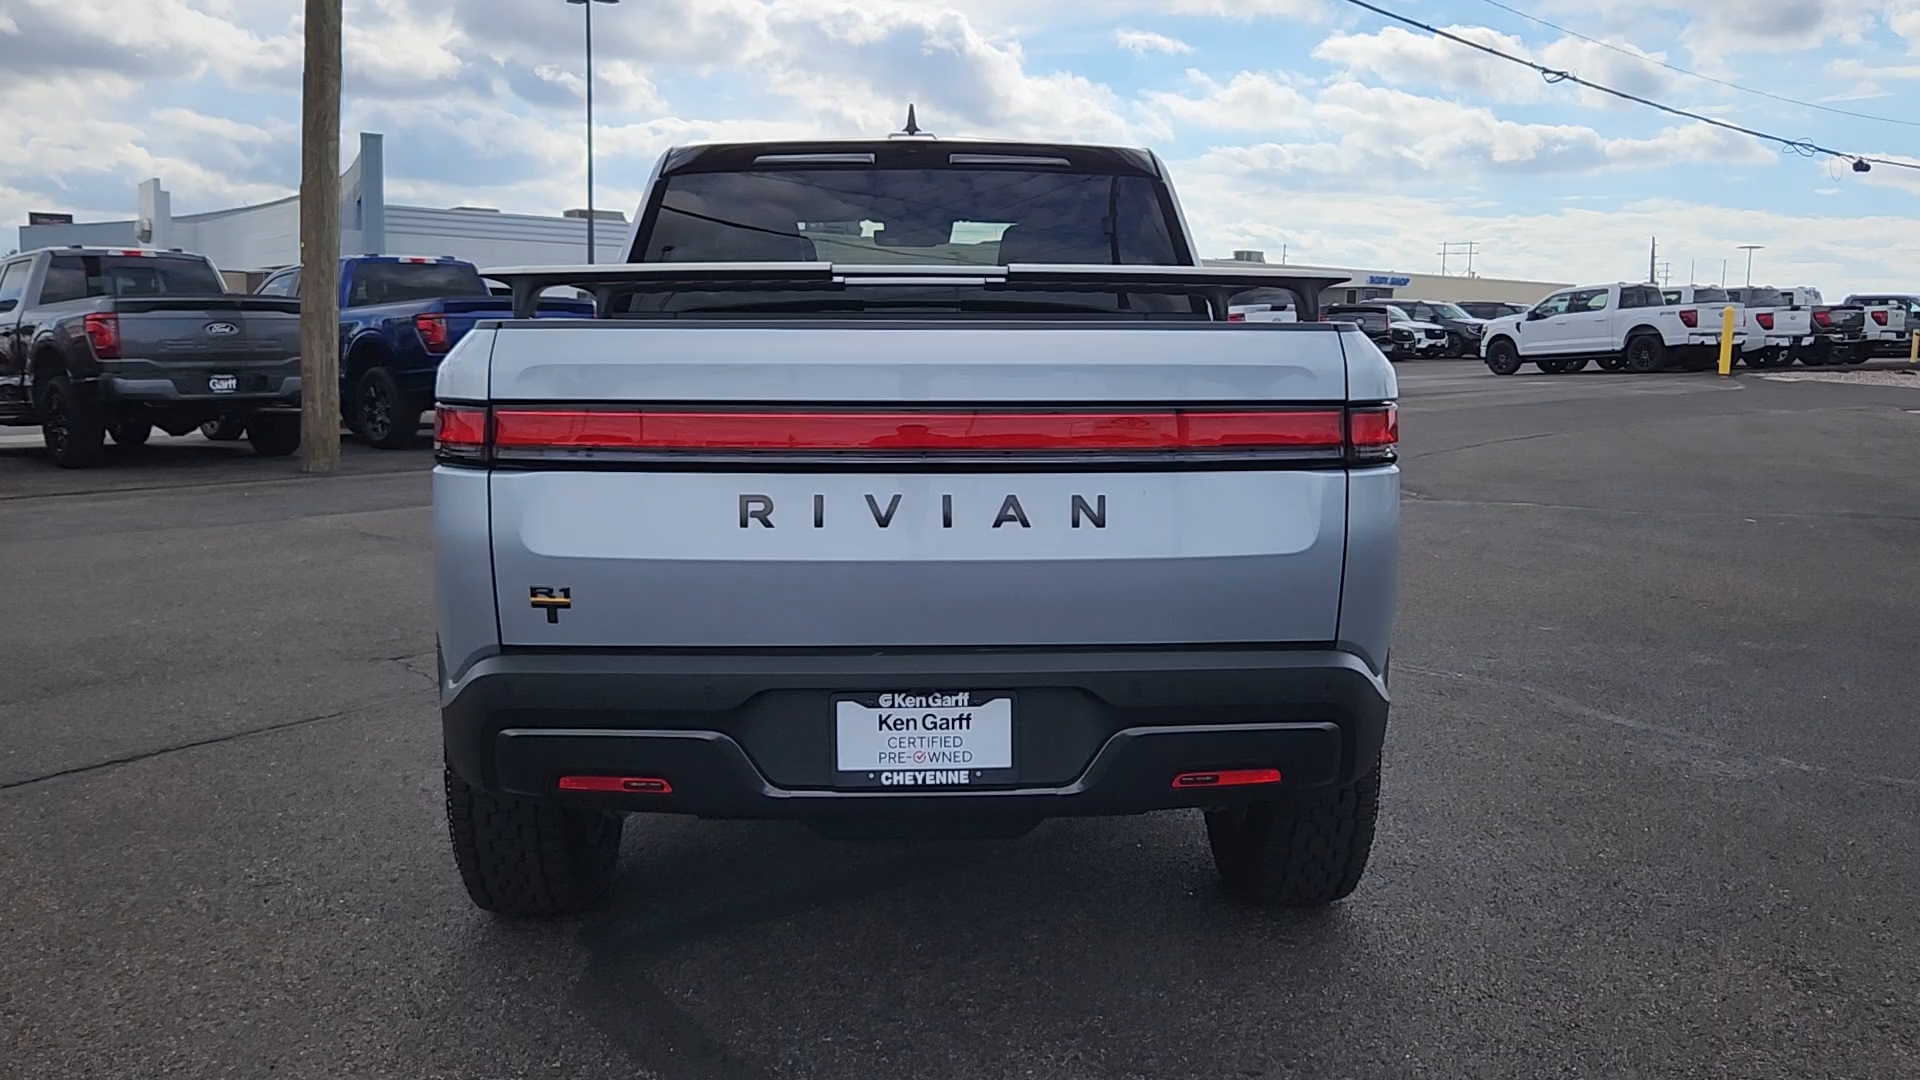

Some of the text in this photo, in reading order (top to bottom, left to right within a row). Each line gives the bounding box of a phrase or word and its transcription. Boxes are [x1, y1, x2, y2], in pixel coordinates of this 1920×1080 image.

[209, 379, 237, 390] Garff
[738, 493, 1107, 529] RIVIAN
[894, 693, 926, 708] Ken
[928, 692, 970, 707] Garff
[878, 712, 972, 731] Ken Garff
[887, 735, 963, 749] CERTIFIED
[880, 770, 970, 785] CHEYENNE
